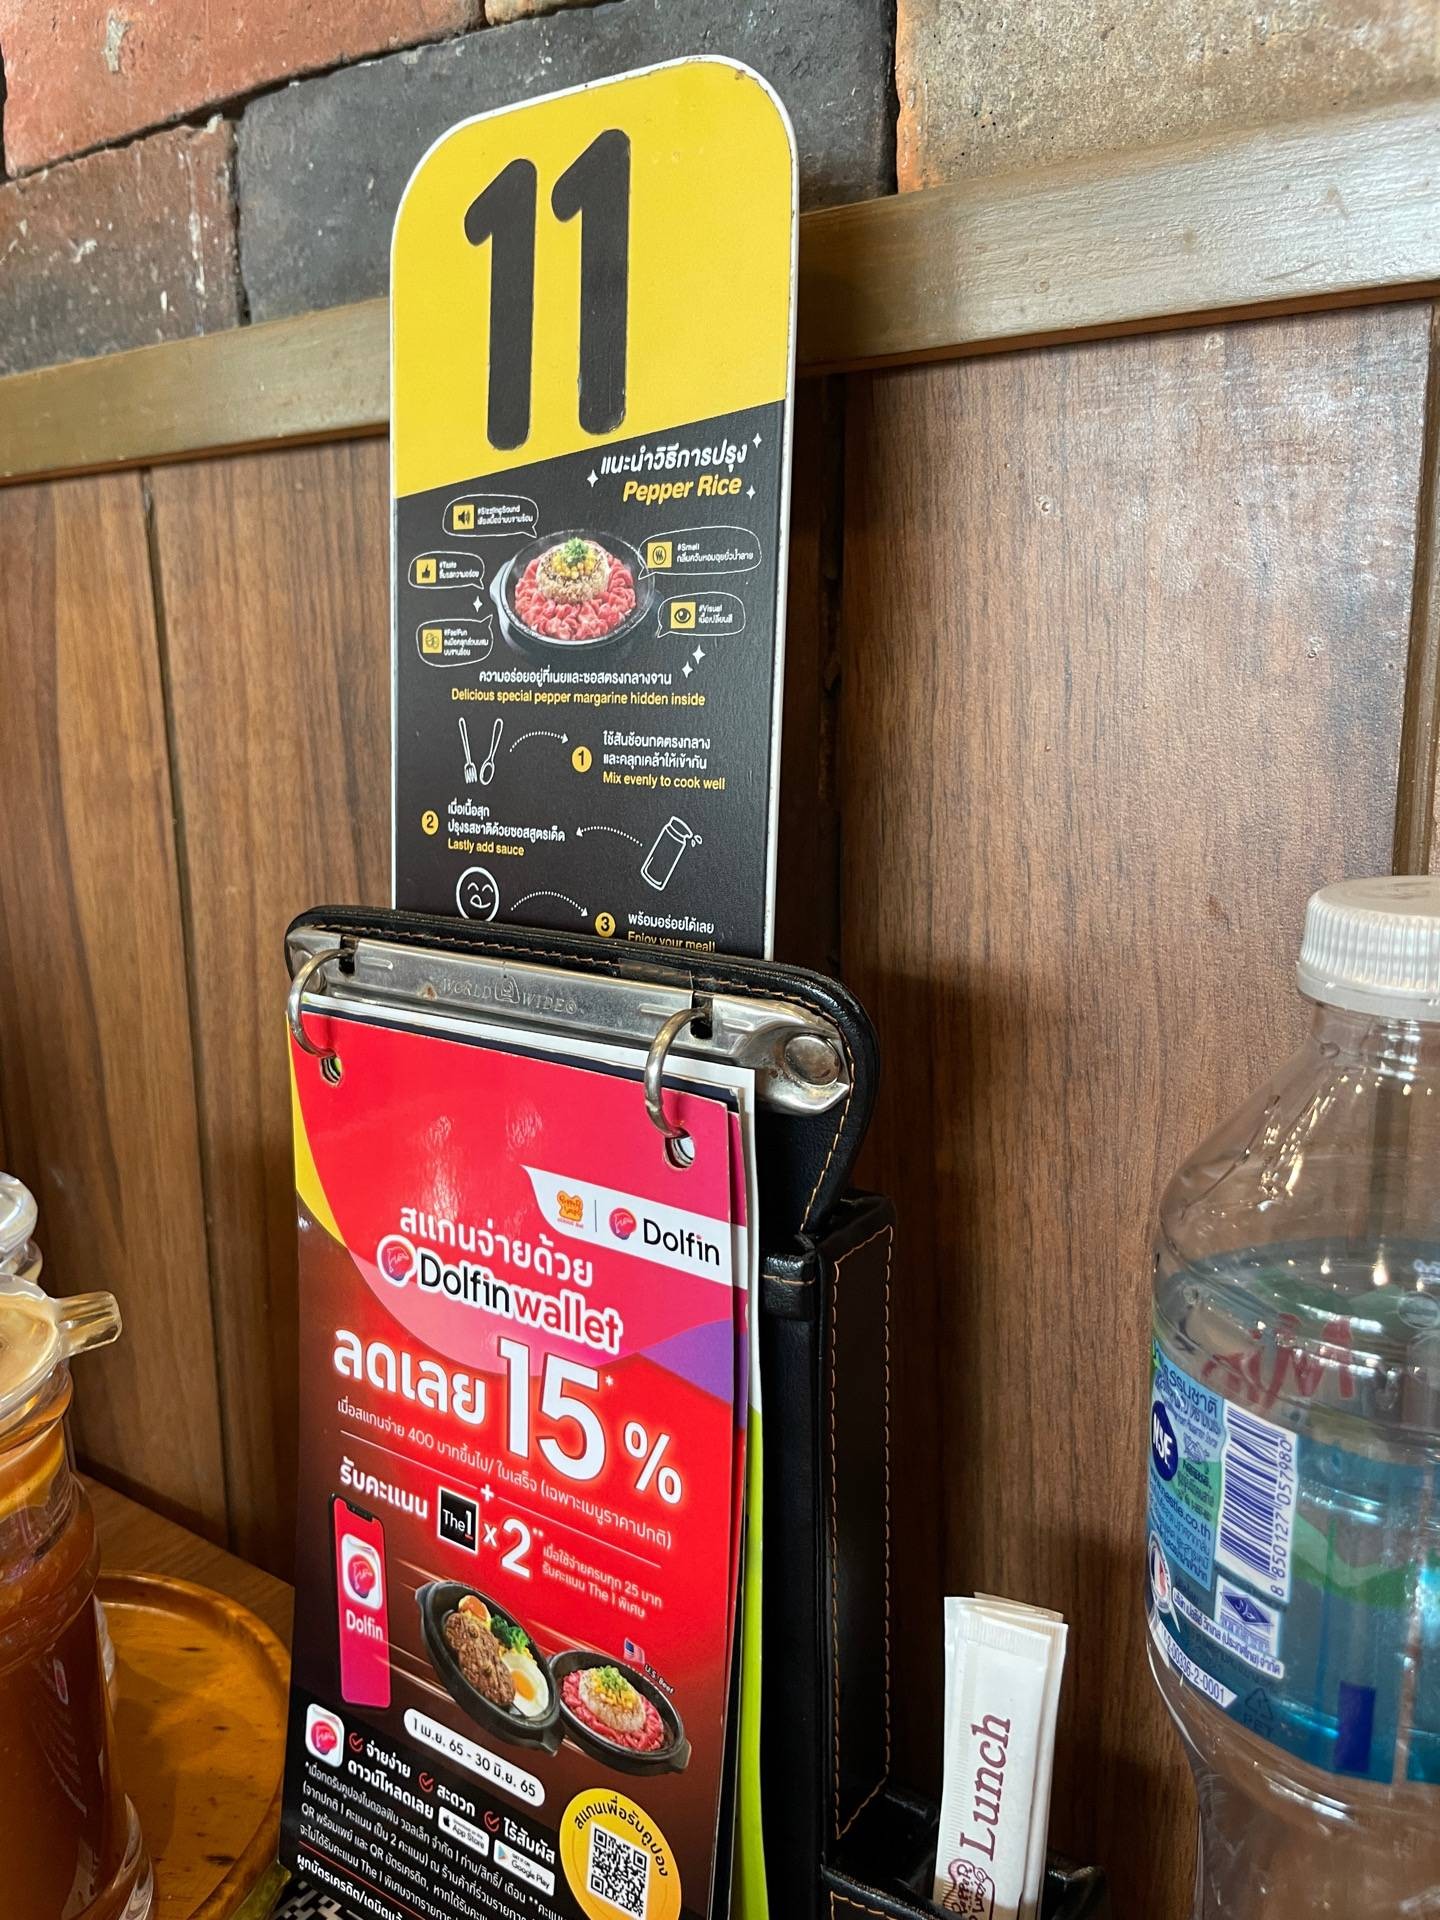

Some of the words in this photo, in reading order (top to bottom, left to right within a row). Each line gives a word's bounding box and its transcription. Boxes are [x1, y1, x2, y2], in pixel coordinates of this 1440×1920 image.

[464, 128, 631, 451] 11
[600, 438, 748, 475] แนะนำวิธีการปรุง
[622, 480, 694, 505] Pepper
[697, 474, 742, 497] Rice
[677, 543, 700, 552] #Smell
[451, 688, 495, 702] Delicious
[497, 689, 532, 704] special
[534, 692, 571, 705] pepper
[573, 691, 628, 706] margarine
[630, 692, 669, 705] hidden
[671, 692, 706, 706] inside
[479, 666, 672, 687] ความอร่อยอยู่ที่เนยและซอสตรงกลางจาน
[577, 750, 585, 767] 1
[602, 730, 711, 750] ใช้สันช้อนกดตรงกลาง
[603, 752, 707, 770] และคลุกเคล้าให้เข้ากัน
[603, 771, 622, 784] Mix
[623, 773, 658, 789] evenly
[660, 775, 671, 787] to
[673, 776, 701, 789] cook
[702, 777, 726, 790] well
[426, 814, 434, 828] 2
[448, 797, 490, 821] เมื่อเนื้อสุก
[448, 818, 566, 843] ปรุงรสชาติด้วยซอสสูตรเด็ด
[447, 838, 475, 855] Lastly
[476, 841, 495, 853] add
[495, 844, 525, 856] sauce
[600, 916, 610, 932] 3
[628, 911, 715, 934] พร้อมอร่อยได้เลย
[443, 978, 492, 999] WORLD
[400, 1207, 593, 1287] สแกนจ่ายด้วย
[643, 1217, 720, 1266] Dolfin
[333, 1329, 487, 1425] ลดเลย
[1153, 1412, 1173, 1470] NSF
[337, 1397, 405, 1437] เมื่อสแกนจ่าย
[407, 1426, 435, 1449] 400
[496, 1460, 538, 1493] ใบเสร็จ
[541, 1479, 672, 1550] (เฉพาะเมนูราคาปกติ)
[340, 1457, 428, 1520] รับคะแนน
[1277, 1438, 1293, 1506] 057980
[1271, 1511, 1290, 1579] 850127
[542, 1561, 585, 1592] รับคะแนน
[588, 1581, 609, 1602] The
[618, 1597, 645, 1619] พิเศษ
[543, 1543, 622, 1590] เมื่อใช้จ่ายครบทุก
[624, 1580, 639, 1597] 25
[641, 1590, 663, 1609] บาท
[1270, 1584, 1284, 1597] 8
[346, 1608, 384, 1642] Dolfin
[420, 1725, 446, 1747] เม.ย.
[449, 1739, 464, 1756] 65
[474, 1753, 491, 1771] 30
[493, 1762, 517, 1788] มิ.ย.
[520, 1779, 536, 1797] 65
[347, 1759, 434, 1820] ดาวน์โหลดเลย
[366, 1740, 411, 1779] จ่ายง่าย
[436, 1783, 476, 1818] สะดวก
[503, 1816, 556, 1865] ไร้สัมผัส
[960, 1713, 1011, 1862] Lunch
[301, 1802, 315, 1818] QR
[316, 1813, 353, 1841] พร้อมเพย์
[354, 1834, 368, 1851] และ
[369, 1843, 384, 1861] QR
[302, 1780, 339, 1811] (จากปกติ
[345, 1809, 372, 1831] คะแนน
[373, 1822, 389, 1841] เป็น
[390, 1833, 397, 1846] 2
[398, 1840, 428, 1867] คะแนน)
[430, 1859, 440, 1873] ณ
[452, 1824, 467, 1838] App
[467, 1832, 485, 1849] Store
[574, 1795, 668, 1877] สแกนเพื่อรับคูปอง
[300, 1824, 359, 1868] จะไม่ได้รับคะแนน
[361, 1858, 378, 1878] The
[431, 1836, 453, 1857] จำกัด
[504, 1882, 526, 1904] เดือน
[511, 1860, 535, 1879] Google
[535, 1873, 550, 1889] Play
